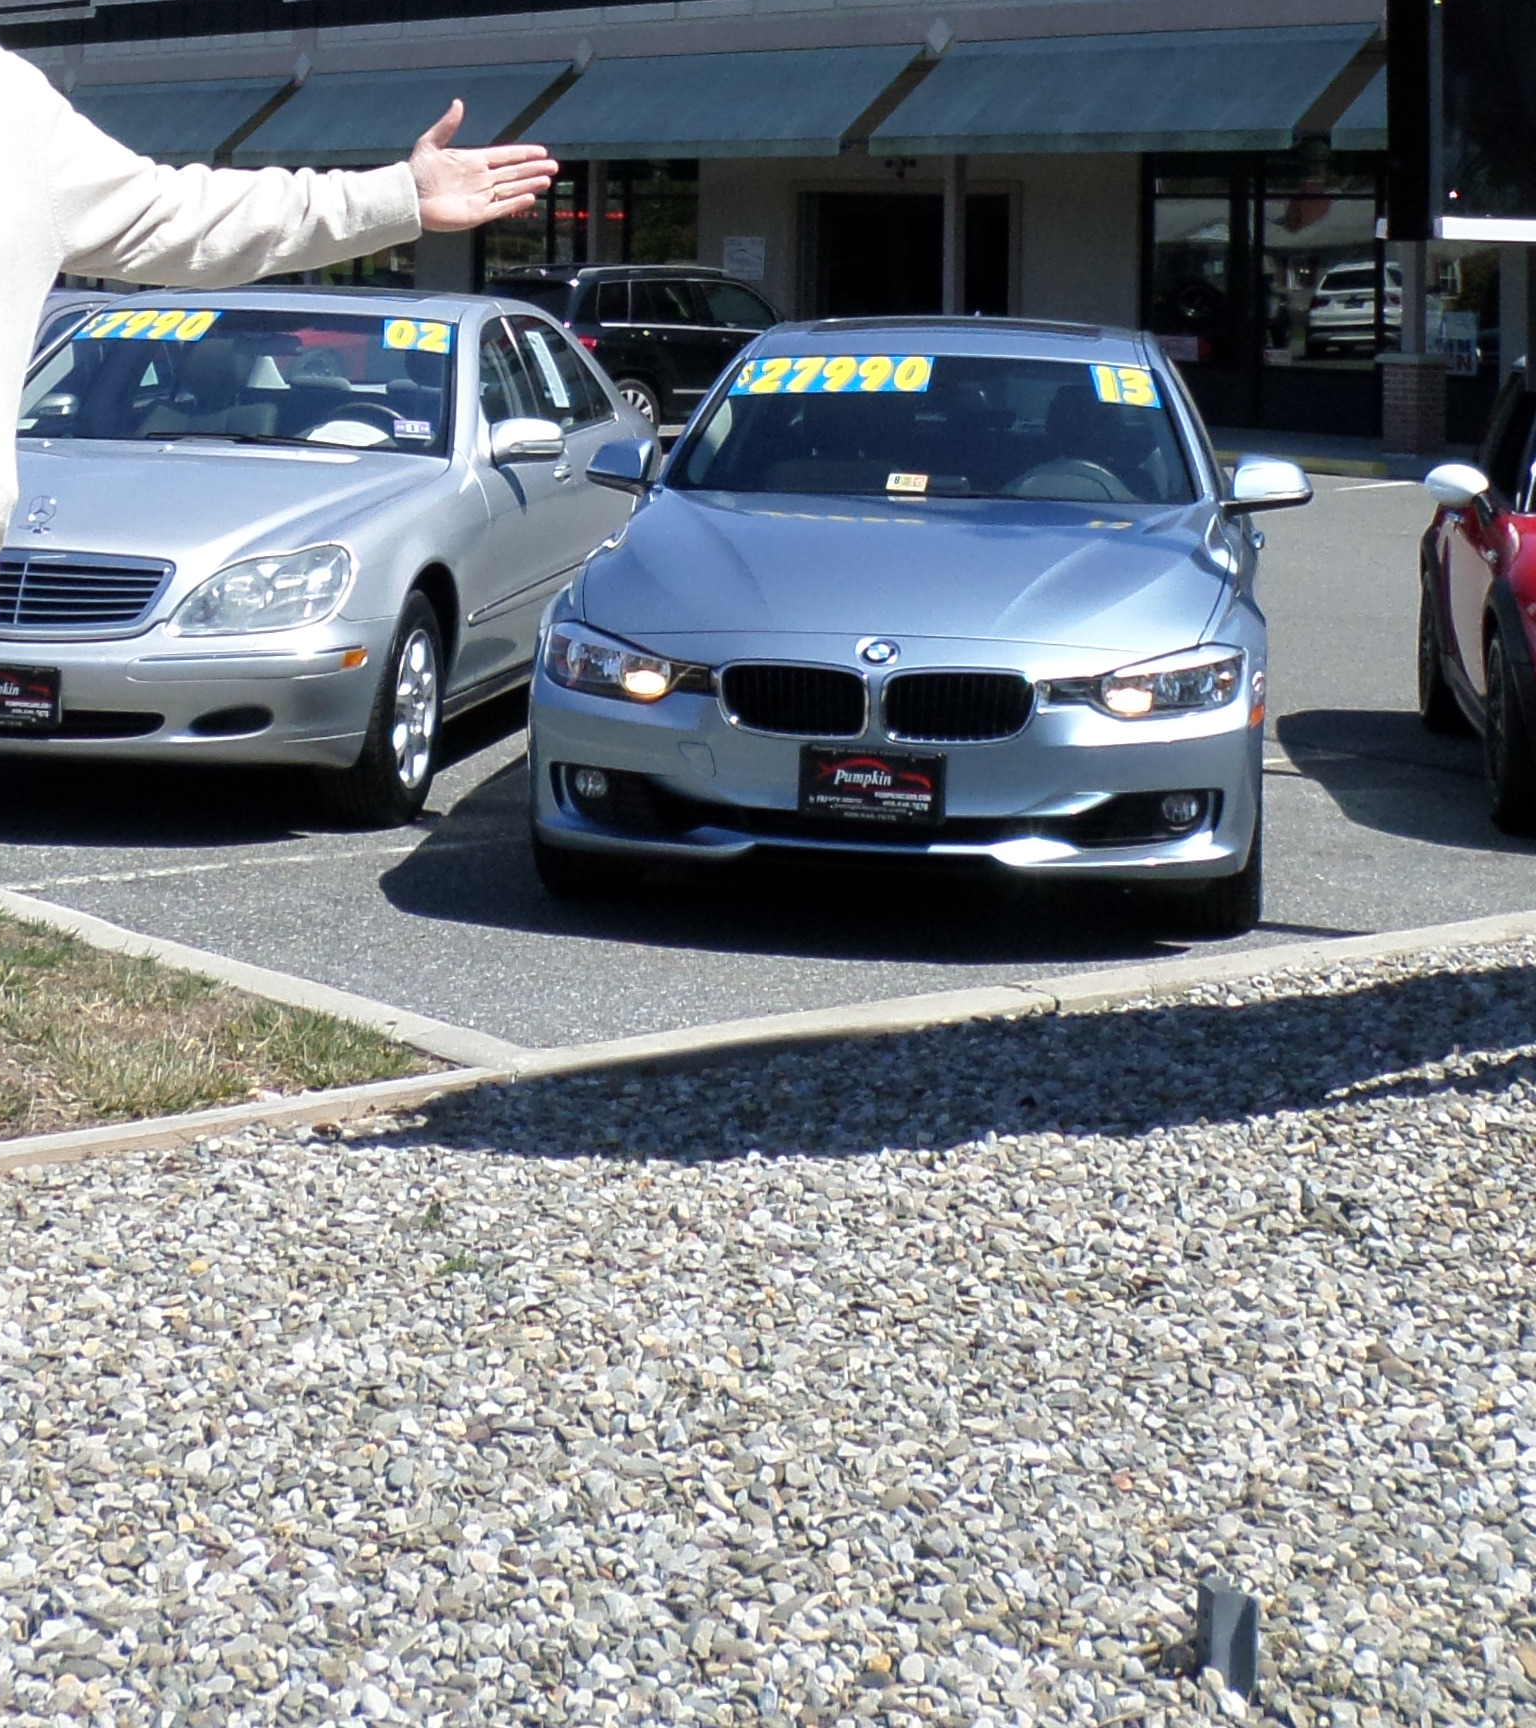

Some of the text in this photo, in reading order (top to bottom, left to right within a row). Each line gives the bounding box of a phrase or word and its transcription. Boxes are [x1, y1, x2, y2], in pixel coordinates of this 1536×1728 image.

[81, 310, 215, 340] $7990
[385, 319, 448, 353] 02
[737, 355, 932, 393] $27990
[1095, 365, 1156, 407] 13
[833, 769, 892, 789] Pumpkin
